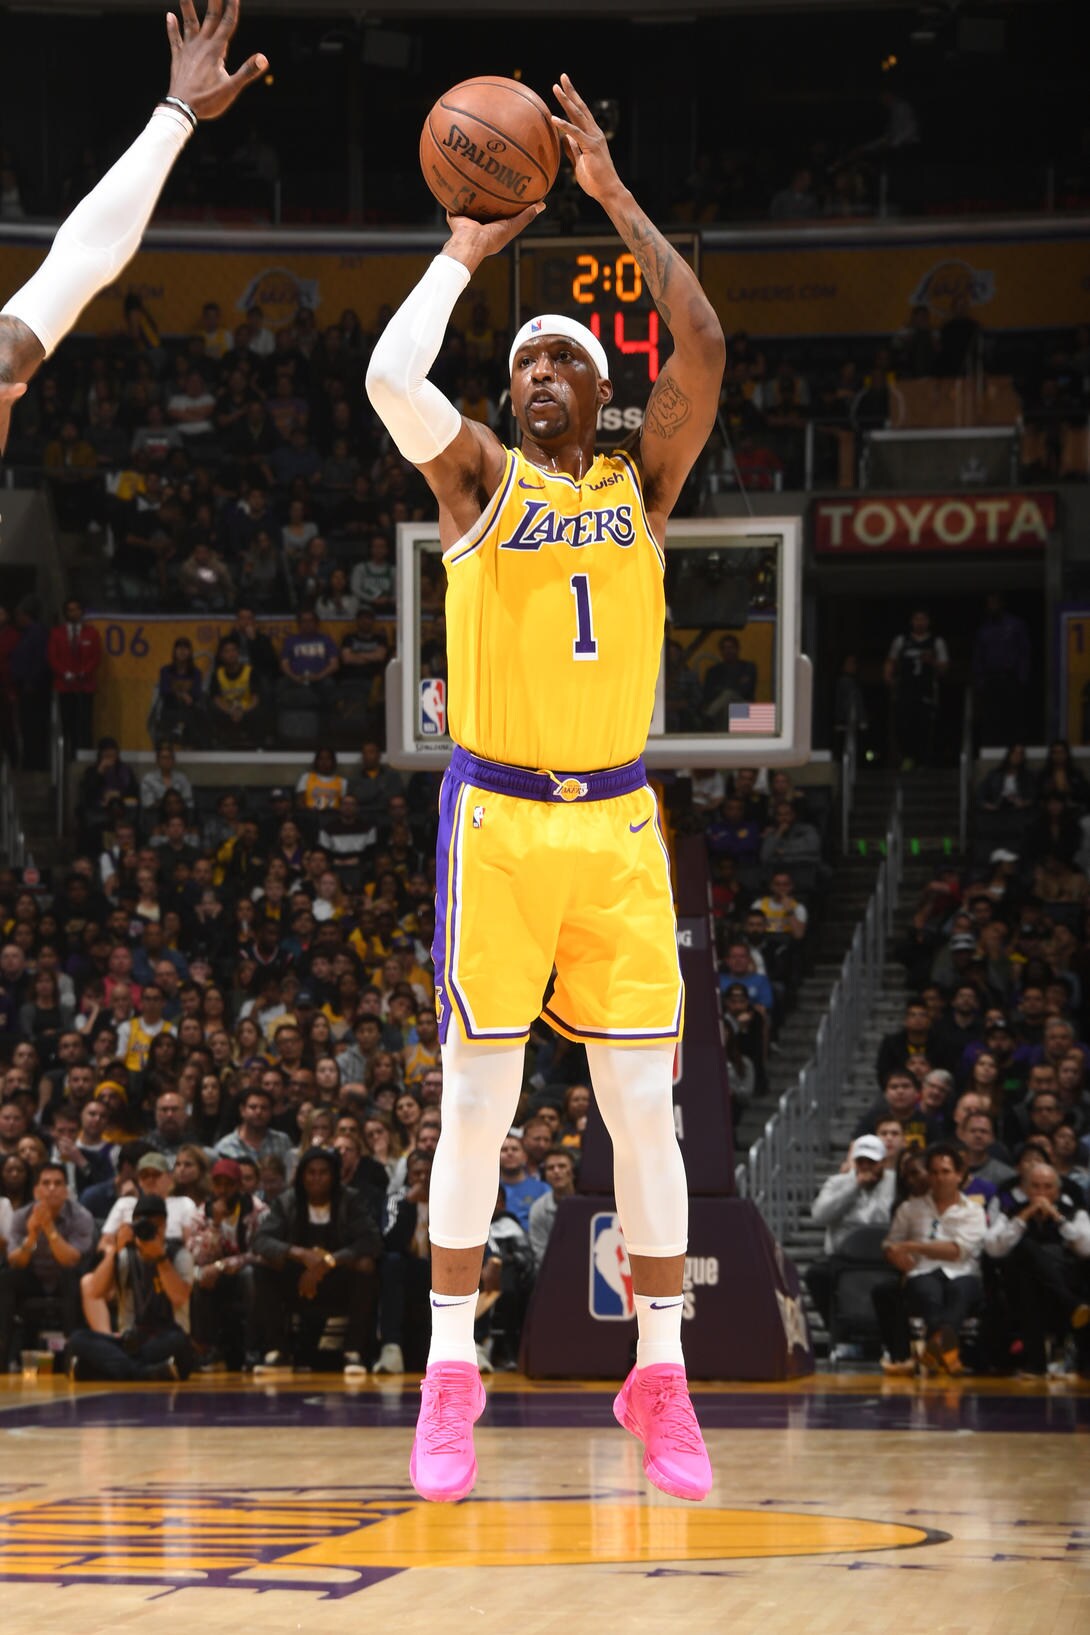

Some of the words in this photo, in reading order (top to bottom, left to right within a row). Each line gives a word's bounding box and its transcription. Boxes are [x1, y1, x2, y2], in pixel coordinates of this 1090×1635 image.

[443, 124, 532, 198] SPALDING
[586, 472, 625, 491] wish
[500, 500, 636, 552] LAKERS
[819, 501, 1047, 546] TOYOTA
[570, 573, 599, 661] 1
